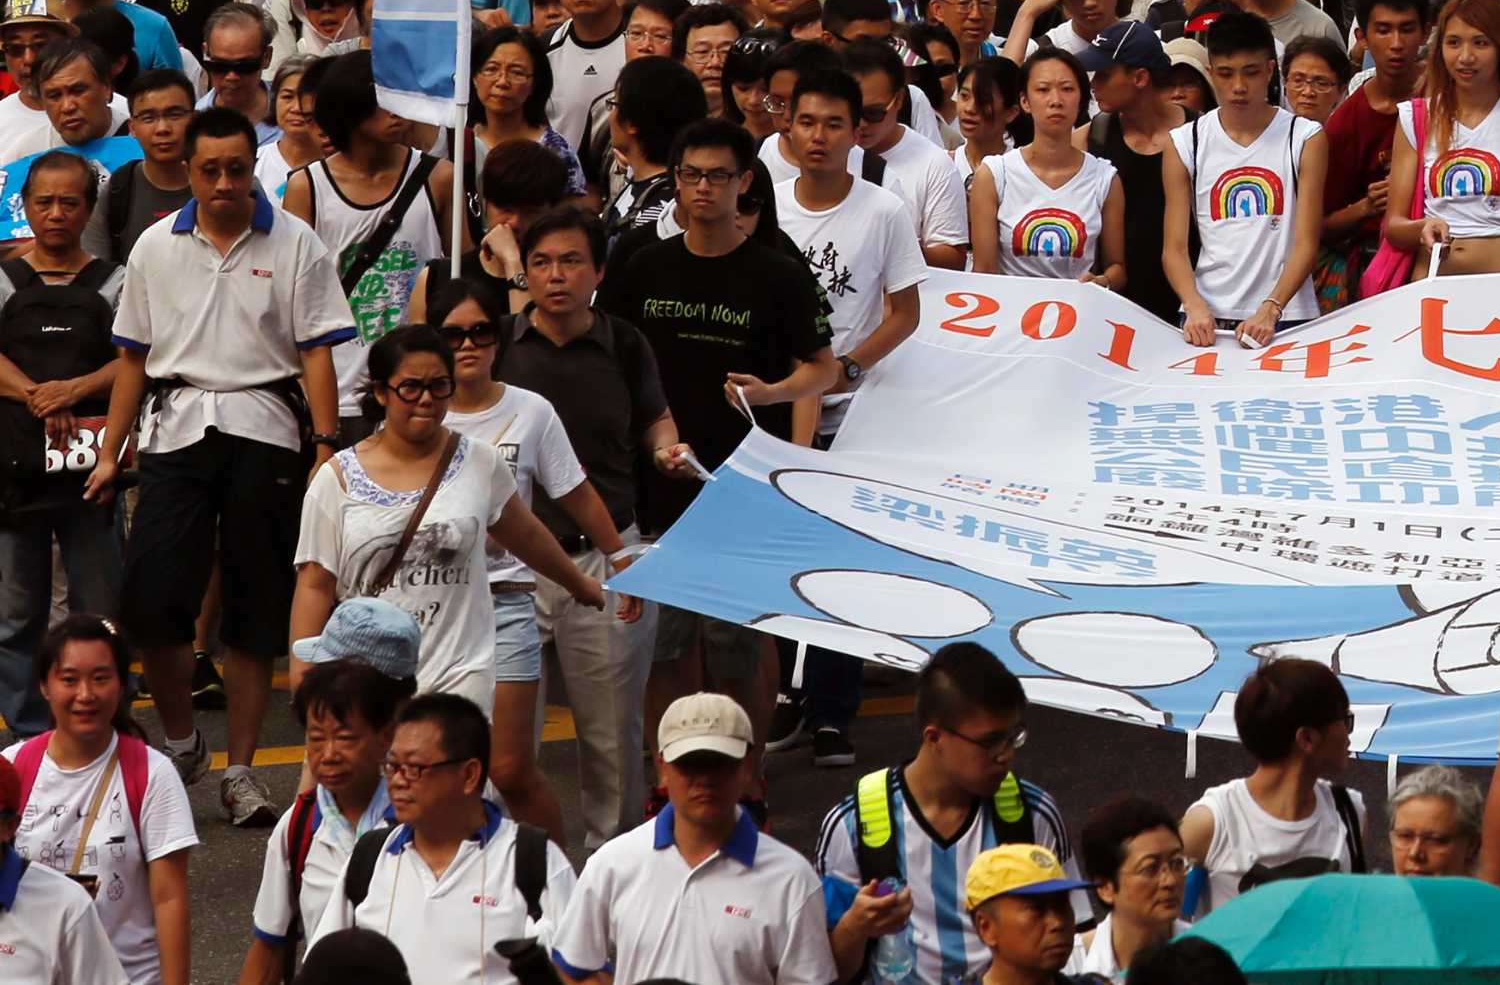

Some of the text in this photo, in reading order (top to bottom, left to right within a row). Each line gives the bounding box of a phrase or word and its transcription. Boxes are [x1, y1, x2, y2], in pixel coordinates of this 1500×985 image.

[643, 298, 751, 329] FREEDOM NOW!
[850, 485, 1157, 570] 梁振英
